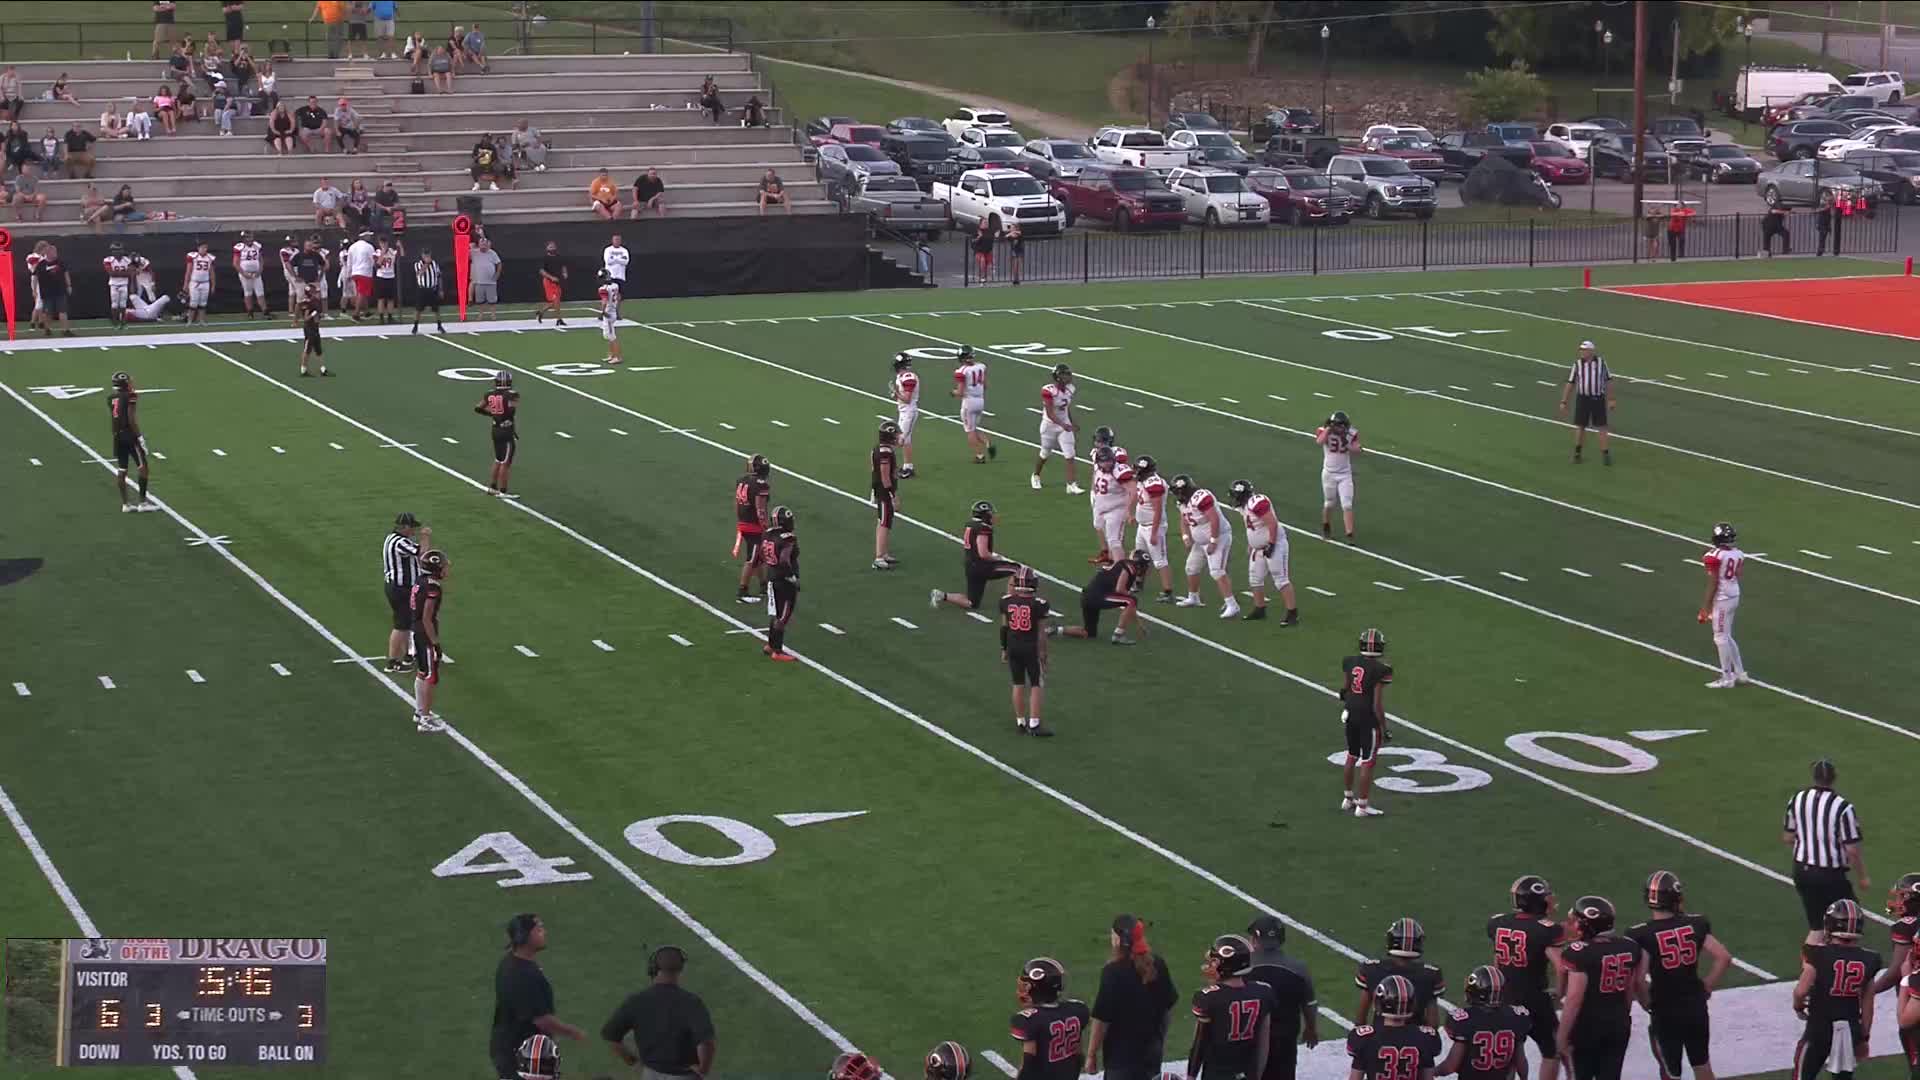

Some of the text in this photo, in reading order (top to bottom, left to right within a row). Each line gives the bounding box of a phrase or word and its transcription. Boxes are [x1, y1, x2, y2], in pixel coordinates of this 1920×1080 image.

[1007, 603, 1032, 631] 38
[1218, 944, 1236, 958] C
[1494, 927, 1529, 968] 53
[1655, 925, 1698, 970] 55
[1028, 967, 1046, 981] C
[1600, 952, 1634, 994] 65
[1829, 958, 1866, 998] 12
[1047, 1015, 1082, 1063] 22
[1227, 999, 1261, 1042] 17
[1375, 1045, 1420, 1080] 33
[1471, 1030, 1516, 1071] 39
